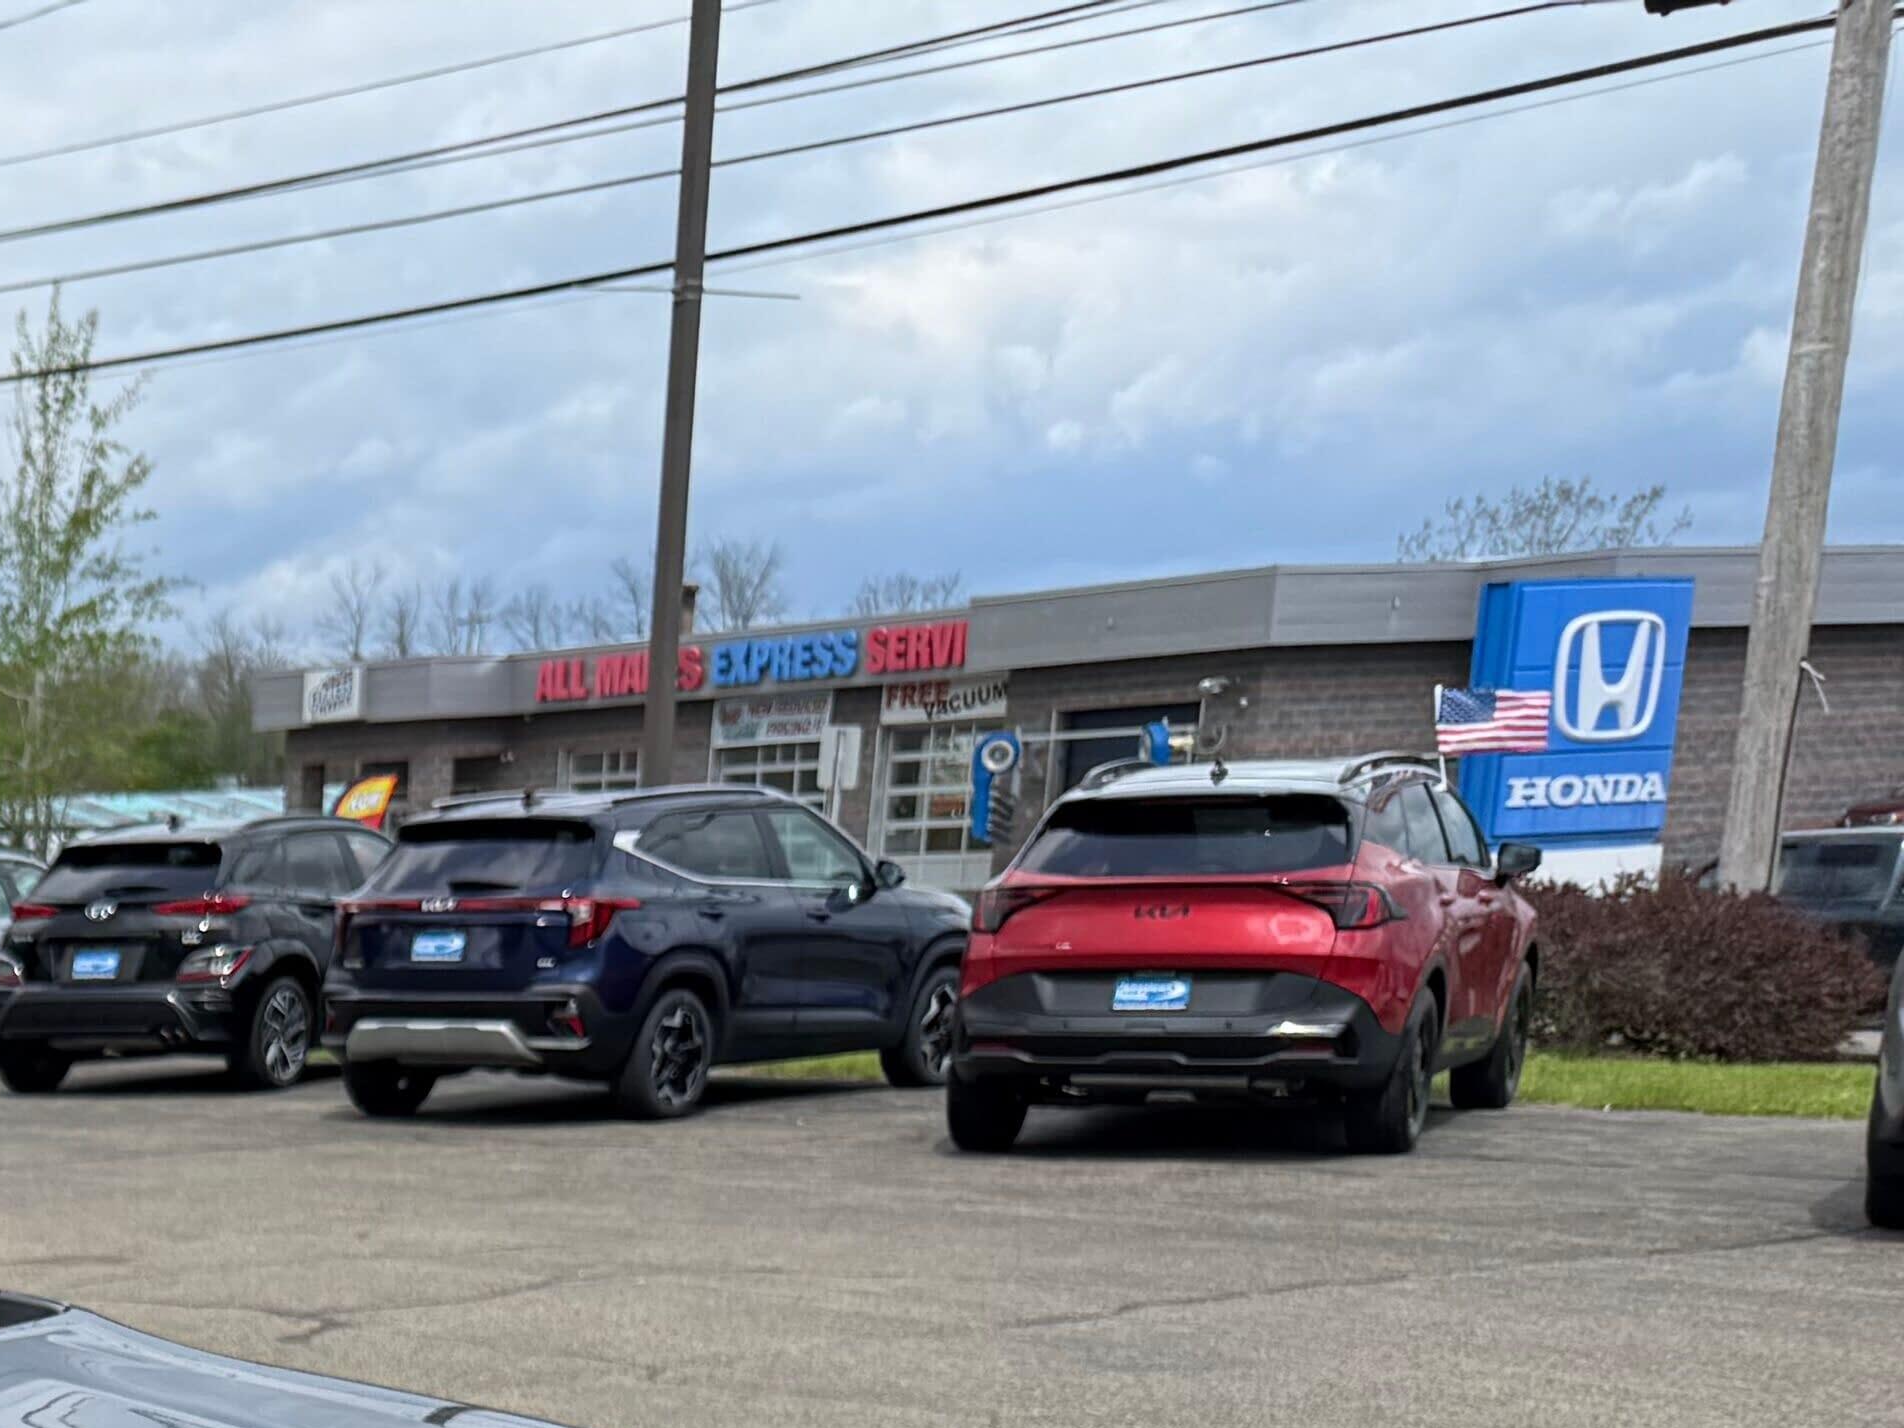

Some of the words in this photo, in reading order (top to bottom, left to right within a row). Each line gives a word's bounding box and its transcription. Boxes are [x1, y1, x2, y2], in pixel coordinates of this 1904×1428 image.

[535, 658, 588, 703] ALL
[595, 644, 704, 699] MAS
[711, 628, 859, 687] EXPRESS
[866, 620, 969, 675] SERVI
[884, 680, 950, 710] FREE
[923, 679, 1011, 721] VACUUM
[1505, 772, 1667, 808] HONDA
